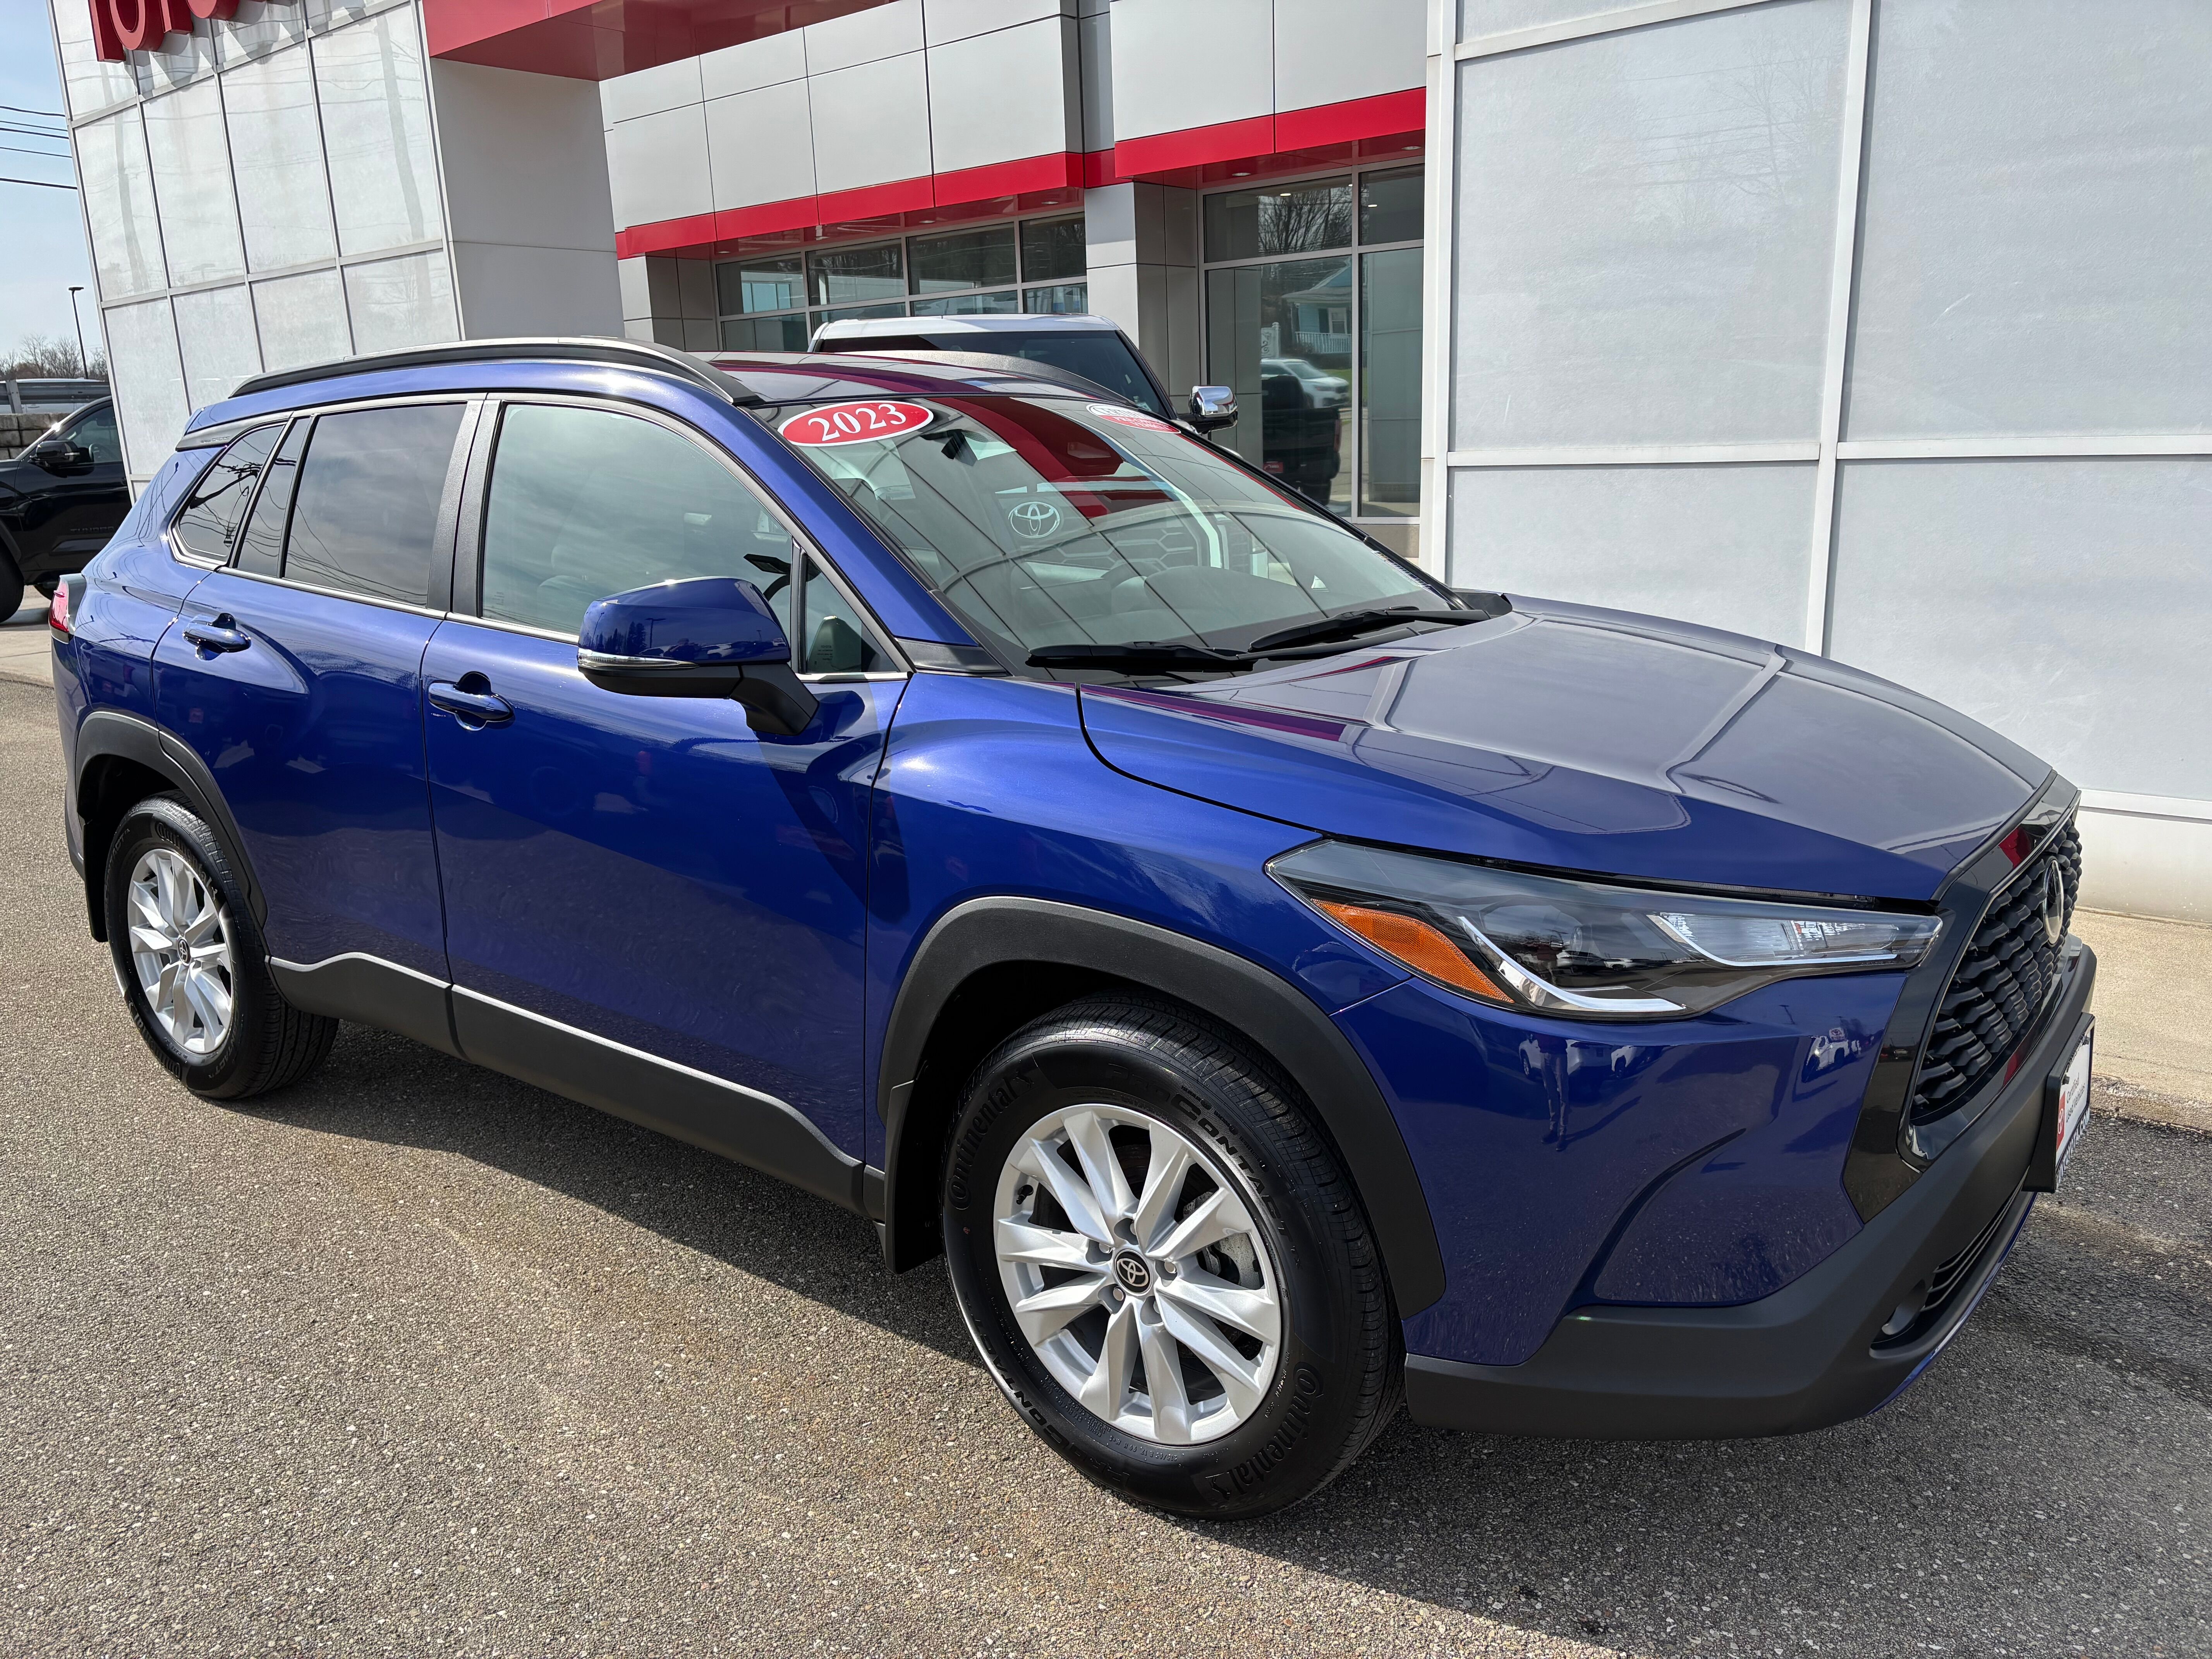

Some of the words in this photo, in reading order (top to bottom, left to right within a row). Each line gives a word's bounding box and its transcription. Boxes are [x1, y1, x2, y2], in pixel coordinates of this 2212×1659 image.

[808, 404, 906, 441] 2023
[947, 1078, 1019, 1211] Continental
[1228, 1360, 1322, 1493] Continental
